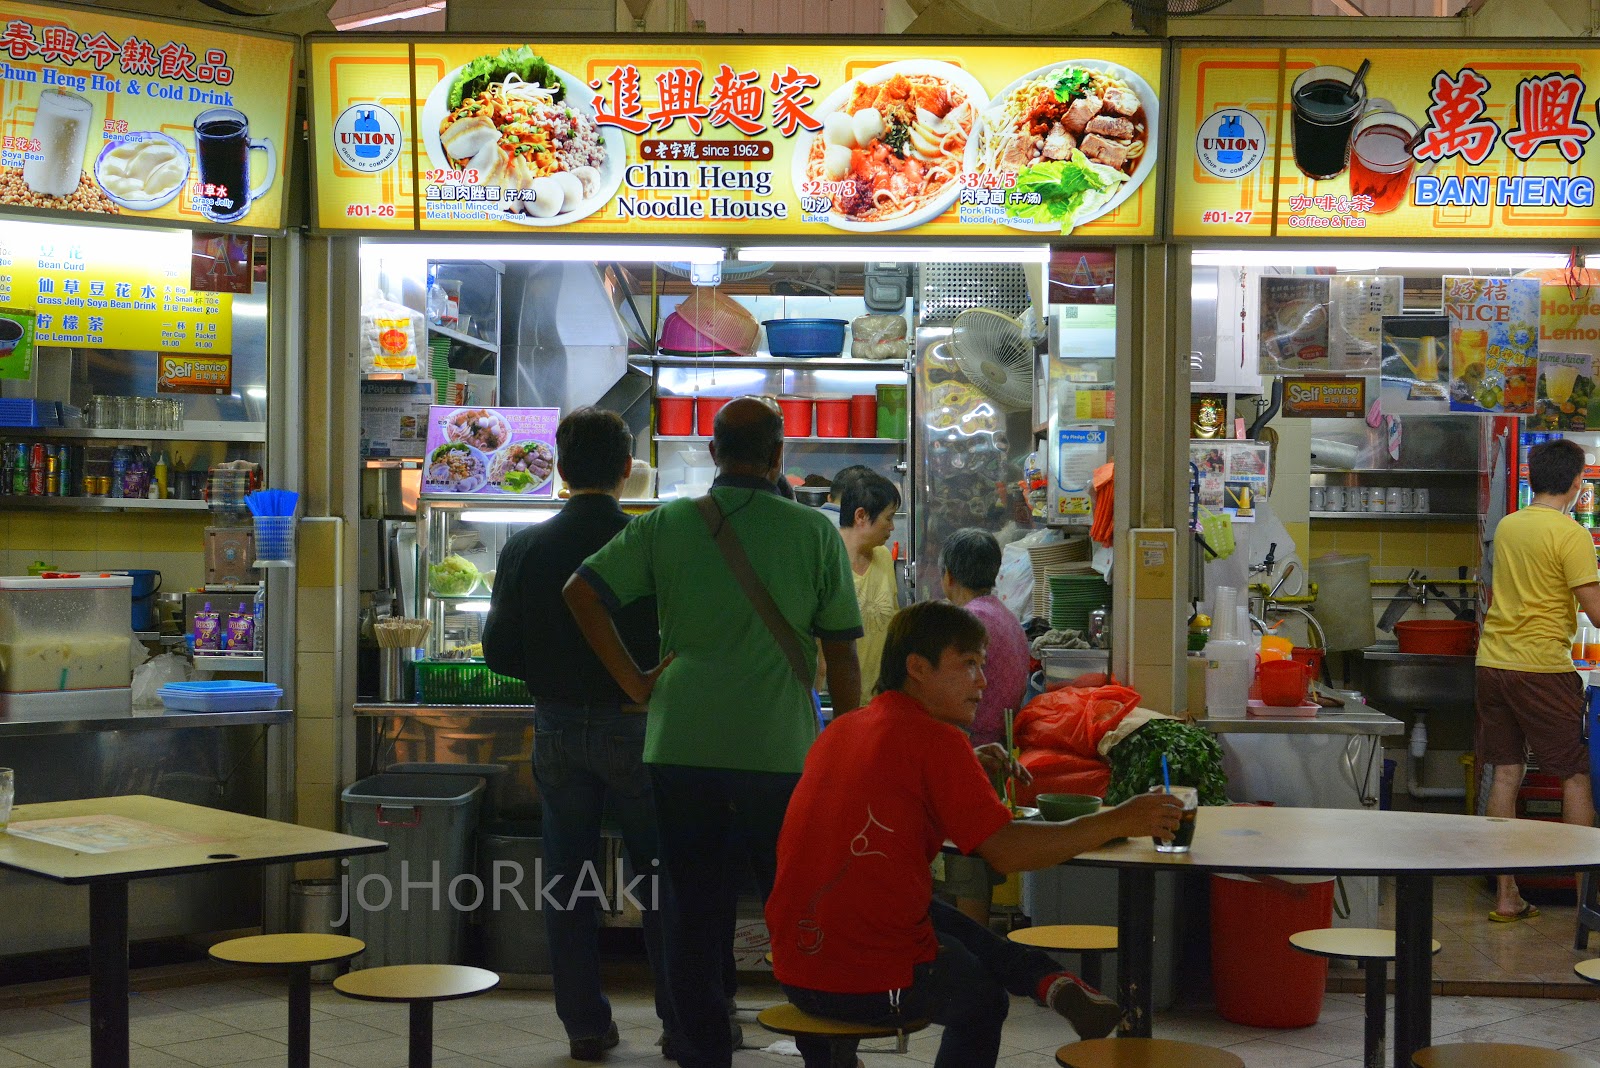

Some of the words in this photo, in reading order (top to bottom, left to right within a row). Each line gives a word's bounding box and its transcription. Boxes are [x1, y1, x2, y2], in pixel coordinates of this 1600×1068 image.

[0, 20, 235, 85] 春興冷熱飲品
[43, 69, 86, 91] Heng
[91, 74, 121, 93] Hot
[127, 80, 141, 95] &
[147, 82, 183, 100] Cold
[188, 87, 234, 106] Drink
[589, 64, 824, 136] 進興麵家
[103, 120, 128, 133] 豆花
[2, 136, 41, 152] 豆花水
[103, 132, 122, 141] Bean
[124, 134, 143, 143] Curd
[340, 132, 395, 145] UNION
[1203, 138, 1259, 150] UNION
[2, 150, 22, 159] Soya
[25, 153, 45, 161] Bean
[655, 142, 699, 159] 老字號
[702, 144, 729, 156] since
[733, 145, 759, 157] 1962
[2, 159, 24, 167] Drink
[342, 148, 355, 162] GROUP
[369, 148, 394, 168] COMPANIES
[1203, 153, 1217, 168] GROUP
[1230, 154, 1257, 173] COMPANIES
[625, 164, 690, 188] Chin
[699, 165, 772, 194] Heng
[959, 172, 1016, 188] $3/4/5
[193, 184, 228, 198] 仙草水
[960, 190, 1005, 204] 肉骨面
[1415, 176, 1489, 207] BAN
[1496, 176, 1594, 207] HENG
[192, 197, 214, 206] Grass
[215, 198, 234, 208] Jelly
[192, 205, 212, 213] Drink
[427, 202, 463, 211] Fishball
[466, 202, 499, 211] Minced
[617, 196, 703, 218] Noodle
[710, 197, 787, 218] House
[801, 197, 832, 213] 叻沙
[347, 205, 394, 217] #01-26
[427, 211, 450, 219] Meat
[453, 211, 486, 220] Noodle
[488, 213, 526, 221] (Dry/Soup)
[960, 207, 982, 215] Pork
[984, 207, 1005, 215] Ribs
[1203, 211, 1252, 223] #01-27
[802, 214, 829, 223] Laksa
[960, 216, 993, 224] Noodle
[996, 217, 1034, 225] (Dry/Soup)
[1289, 216, 1329, 227] Coffee
[1332, 216, 1342, 227] &
[1344, 216, 1366, 227] Tea
[38, 260, 61, 269] Bean
[63, 262, 85, 271] Curd
[38, 278, 156, 299] 仙草豆花水
[175, 287, 186, 295] Big
[1450, 279, 1508, 301] 好桔
[37, 295, 62, 305] Grass
[64, 297, 85, 308] Jelly
[87, 298, 108, 309] Soya
[110, 299, 131, 309] Bean
[134, 301, 157, 310] Drink
[182, 305, 203, 313] Packet
[1445, 303, 1511, 322] NICE
[36, 314, 104, 331] 柠檬茶
[35, 332, 50, 341] Ice
[52, 333, 84, 342] Lemon
[86, 334, 103, 343] Tea
[195, 332, 216, 340] Packet
[1540, 325, 1600, 340] Lemo
[1539, 353, 1560, 363] Lime
[1562, 354, 1586, 365] Juice
[165, 360, 192, 379] Self
[195, 362, 226, 371] Service
[1290, 385, 1320, 403] Self
[1322, 386, 1358, 395] Service
